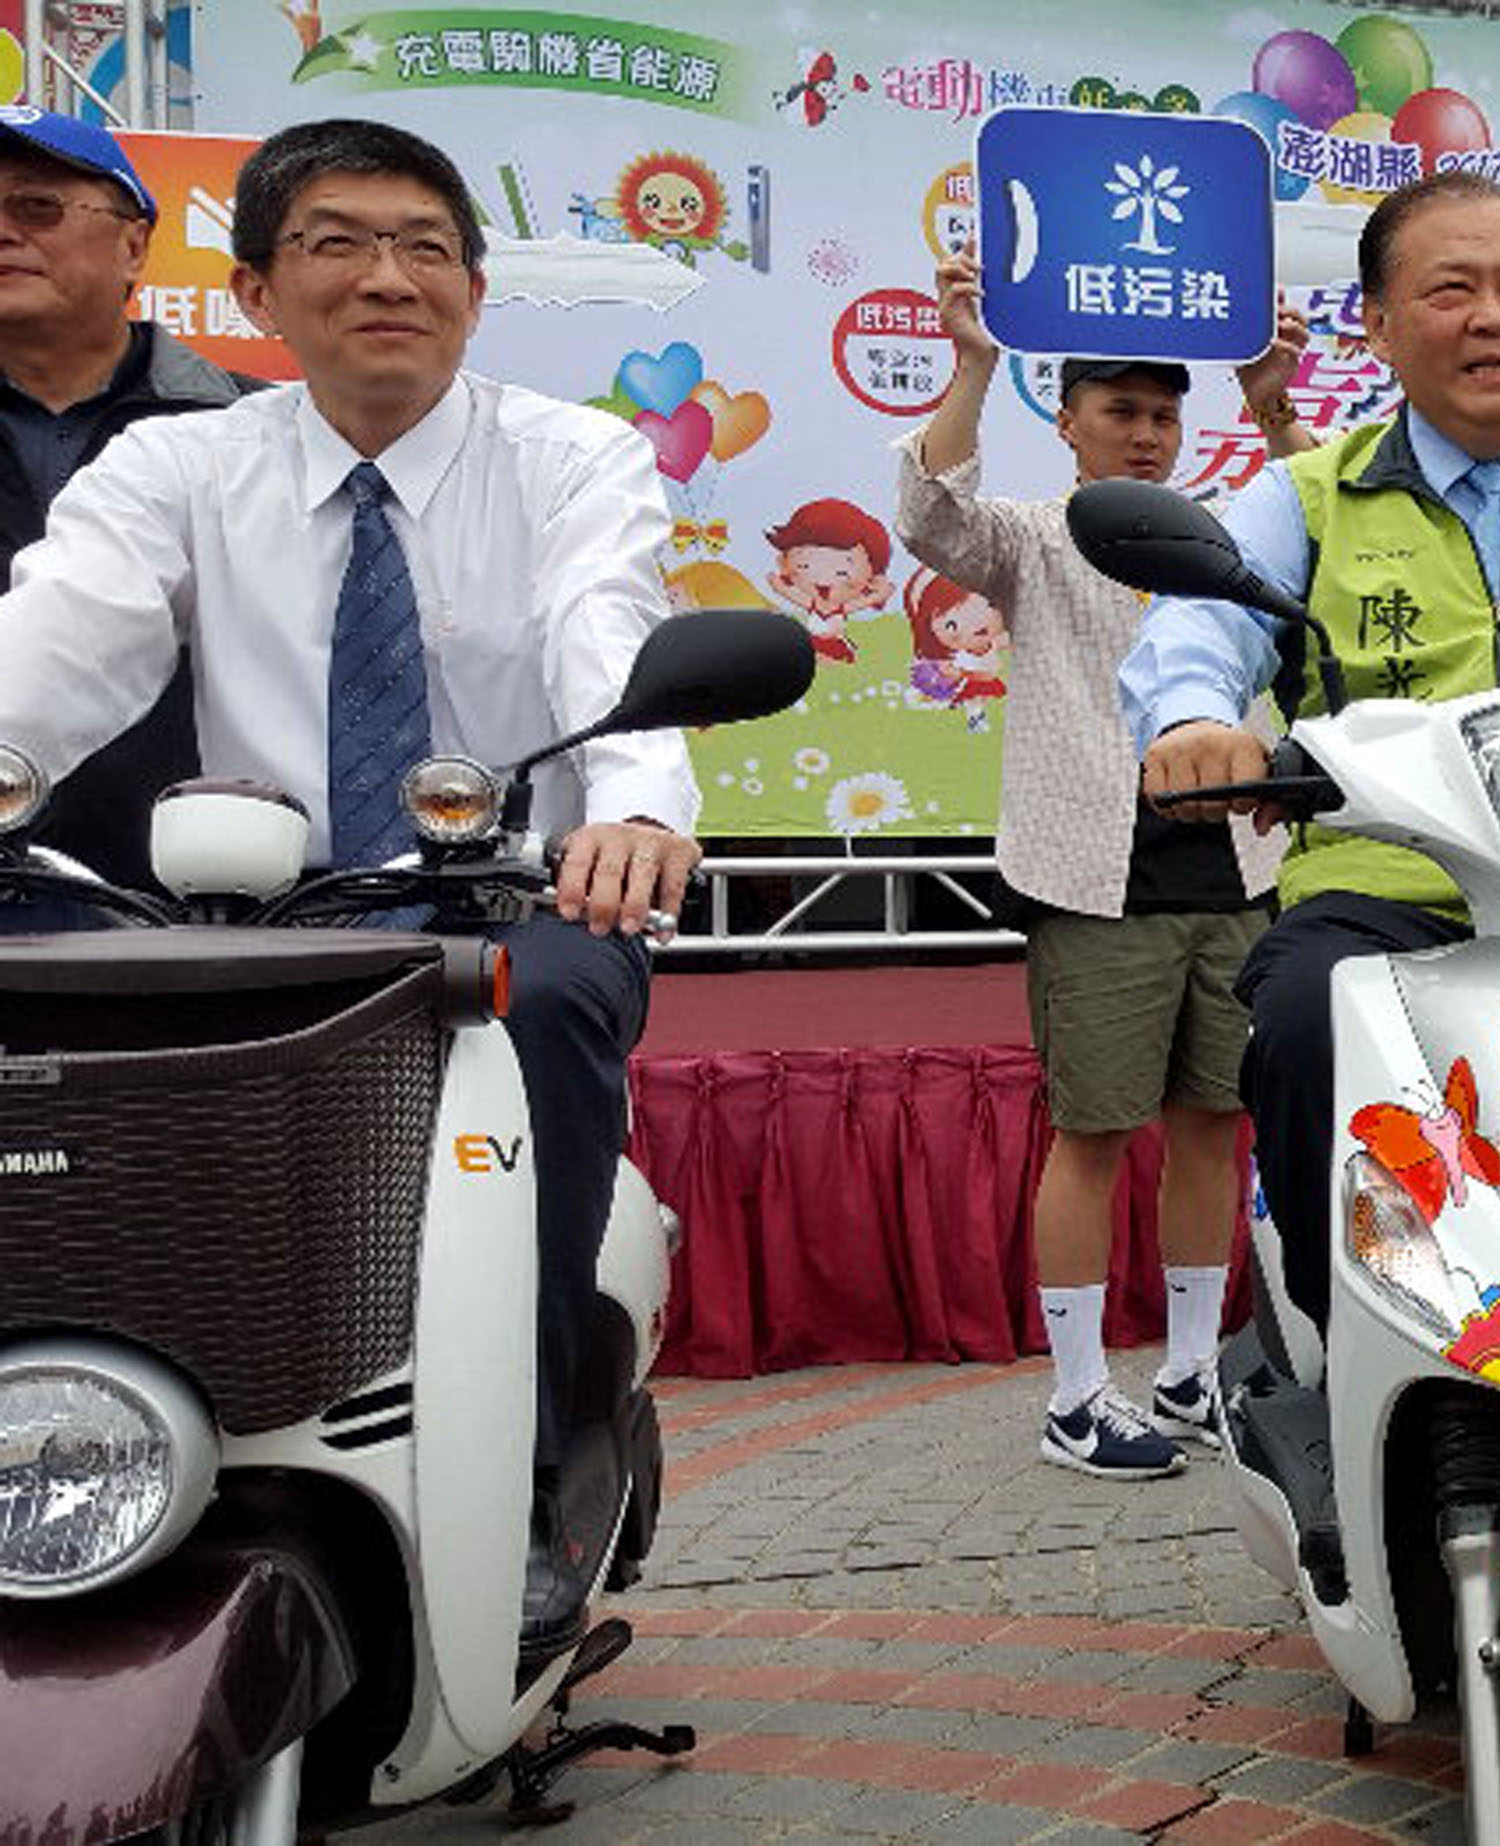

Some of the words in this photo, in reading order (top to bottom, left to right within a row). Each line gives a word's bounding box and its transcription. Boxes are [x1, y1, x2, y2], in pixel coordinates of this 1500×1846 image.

[1282, 127, 1421, 189] 澎湖縣
[1065, 264, 1230, 319] 低污染
[856, 303, 942, 333] 低污染
[455, 1134, 523, 1173] EV
